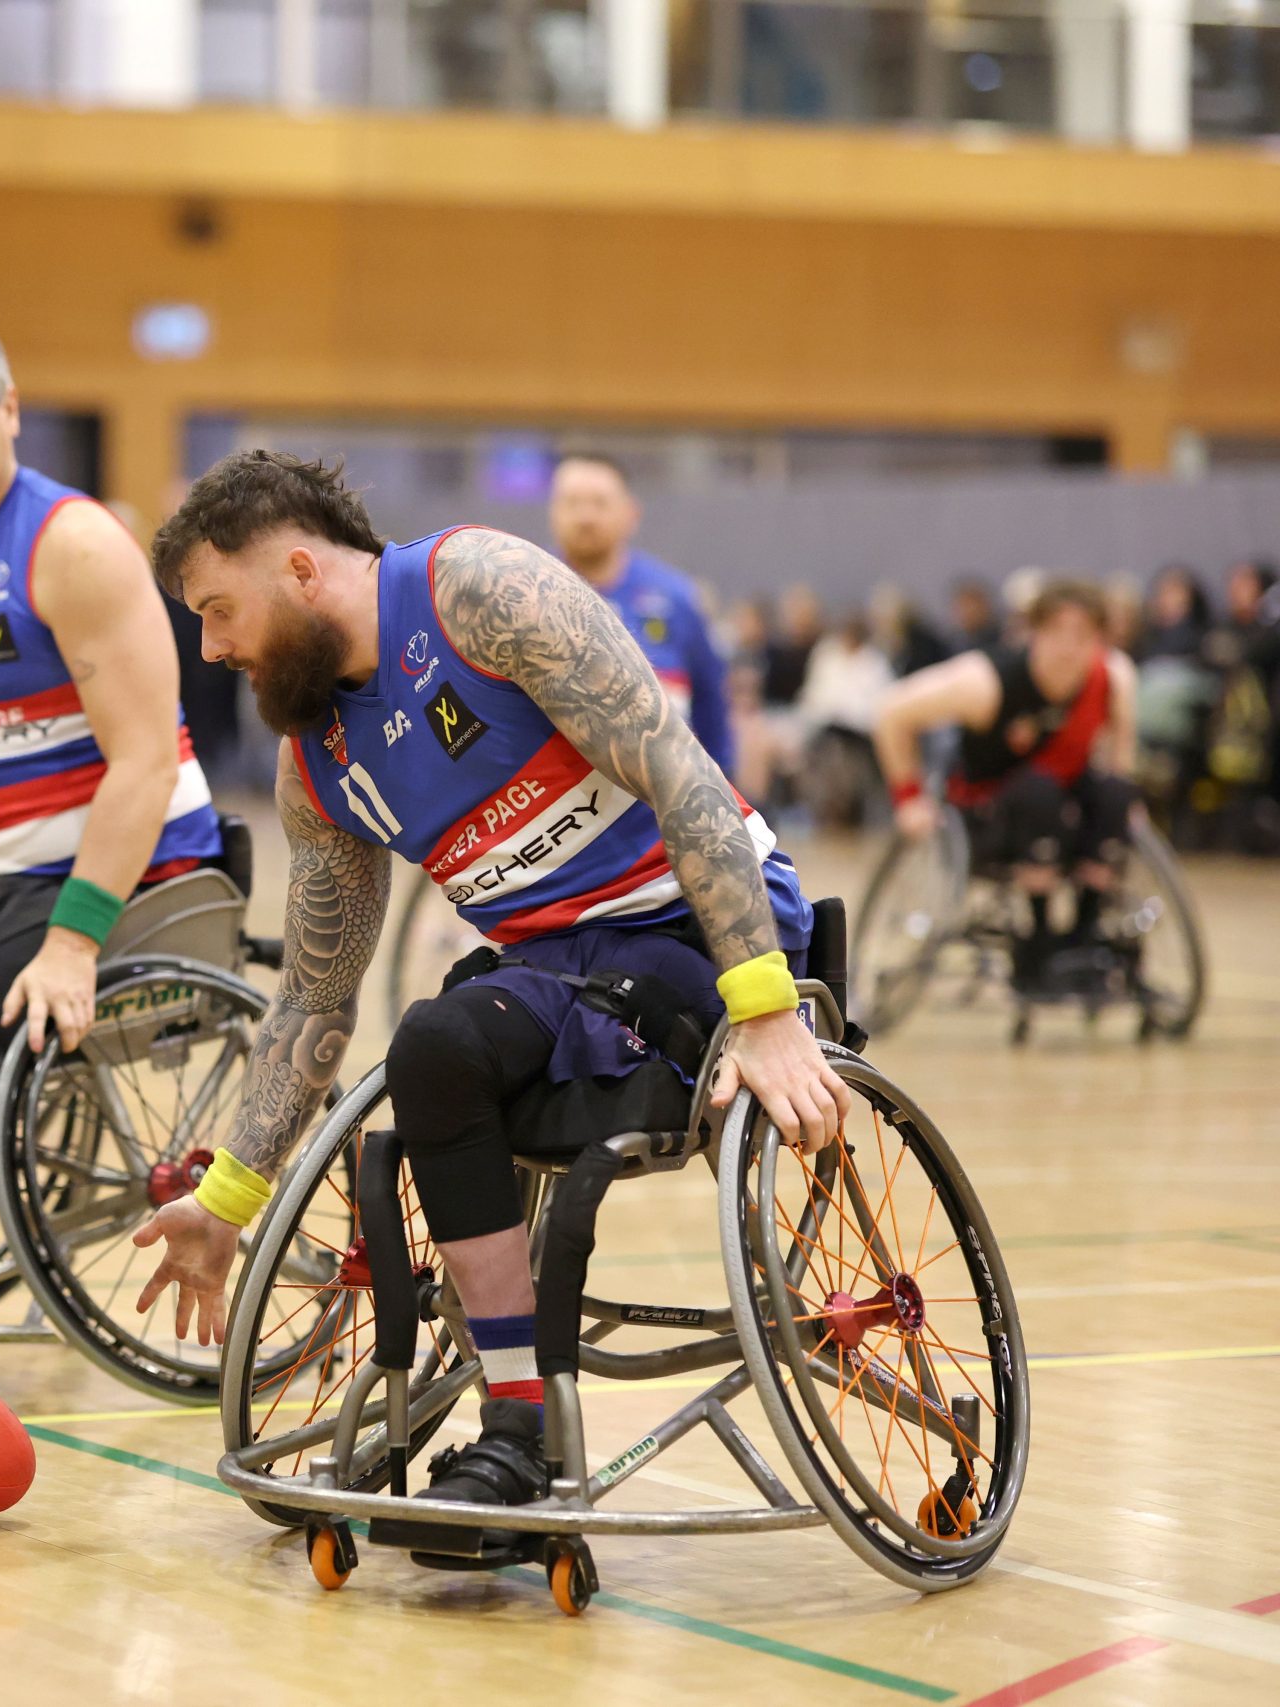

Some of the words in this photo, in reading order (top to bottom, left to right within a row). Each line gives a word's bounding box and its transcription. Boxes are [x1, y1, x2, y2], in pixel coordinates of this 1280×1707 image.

[447, 720, 482, 755] convenience
[339, 761, 403, 845] 11
[431, 823, 482, 873] ETER
[482, 779, 547, 834] PAGE
[474, 789, 599, 890] CHERY
